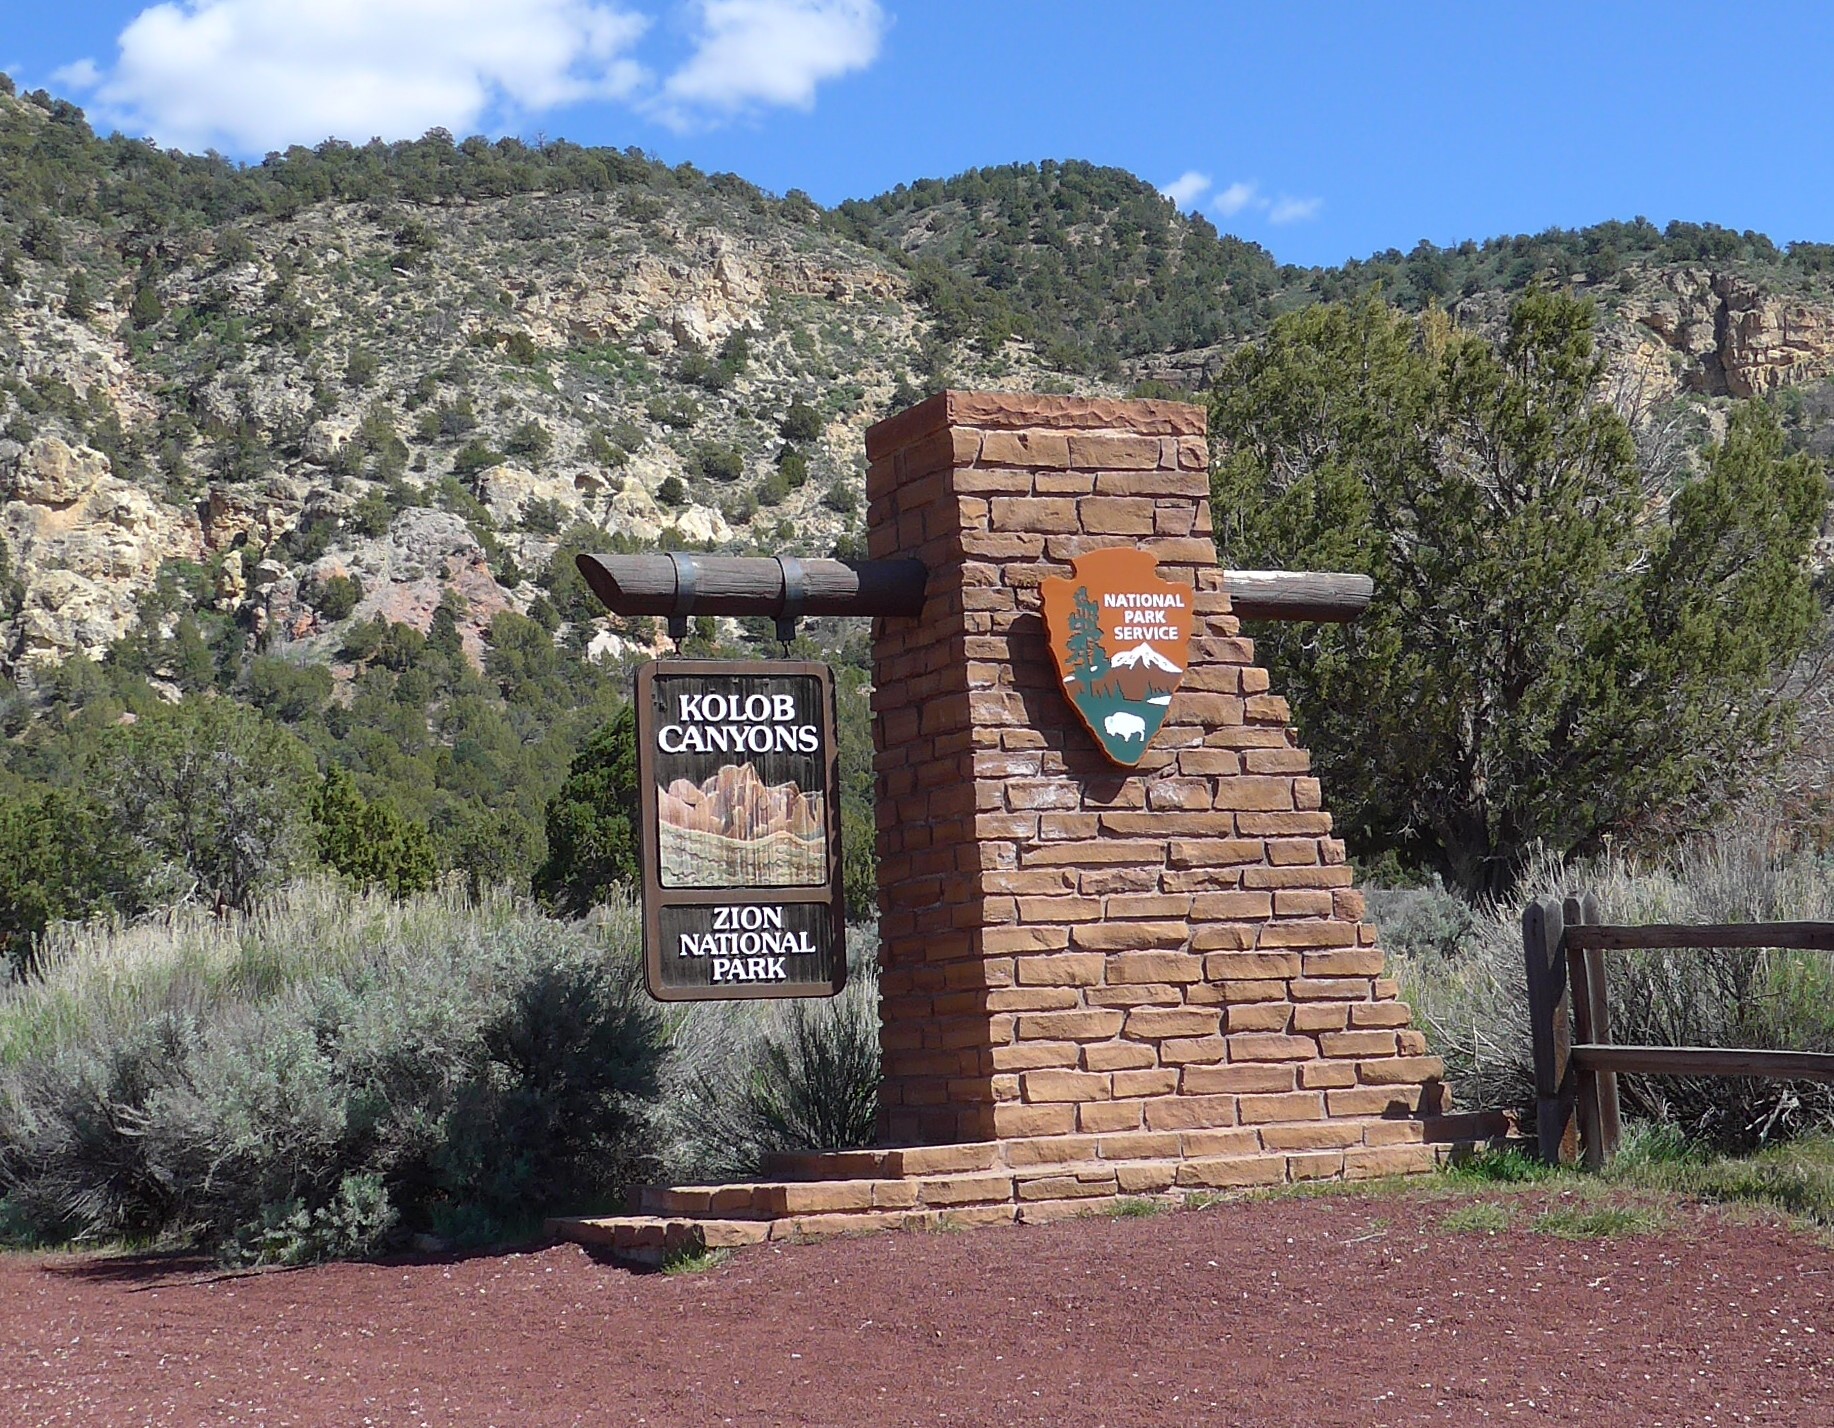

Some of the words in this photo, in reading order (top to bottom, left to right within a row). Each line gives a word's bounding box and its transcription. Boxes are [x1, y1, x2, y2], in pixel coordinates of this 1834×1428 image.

[1104, 593, 1185, 608] NATIONAL
[1124, 610, 1166, 624] PARK
[1114, 626, 1179, 640] SERVICE
[679, 694, 795, 722] KOLOB
[658, 725, 818, 753] CANYONS
[713, 906, 782, 930] ZION
[679, 932, 816, 957] NATIONAL
[712, 957, 786, 981] PARK
